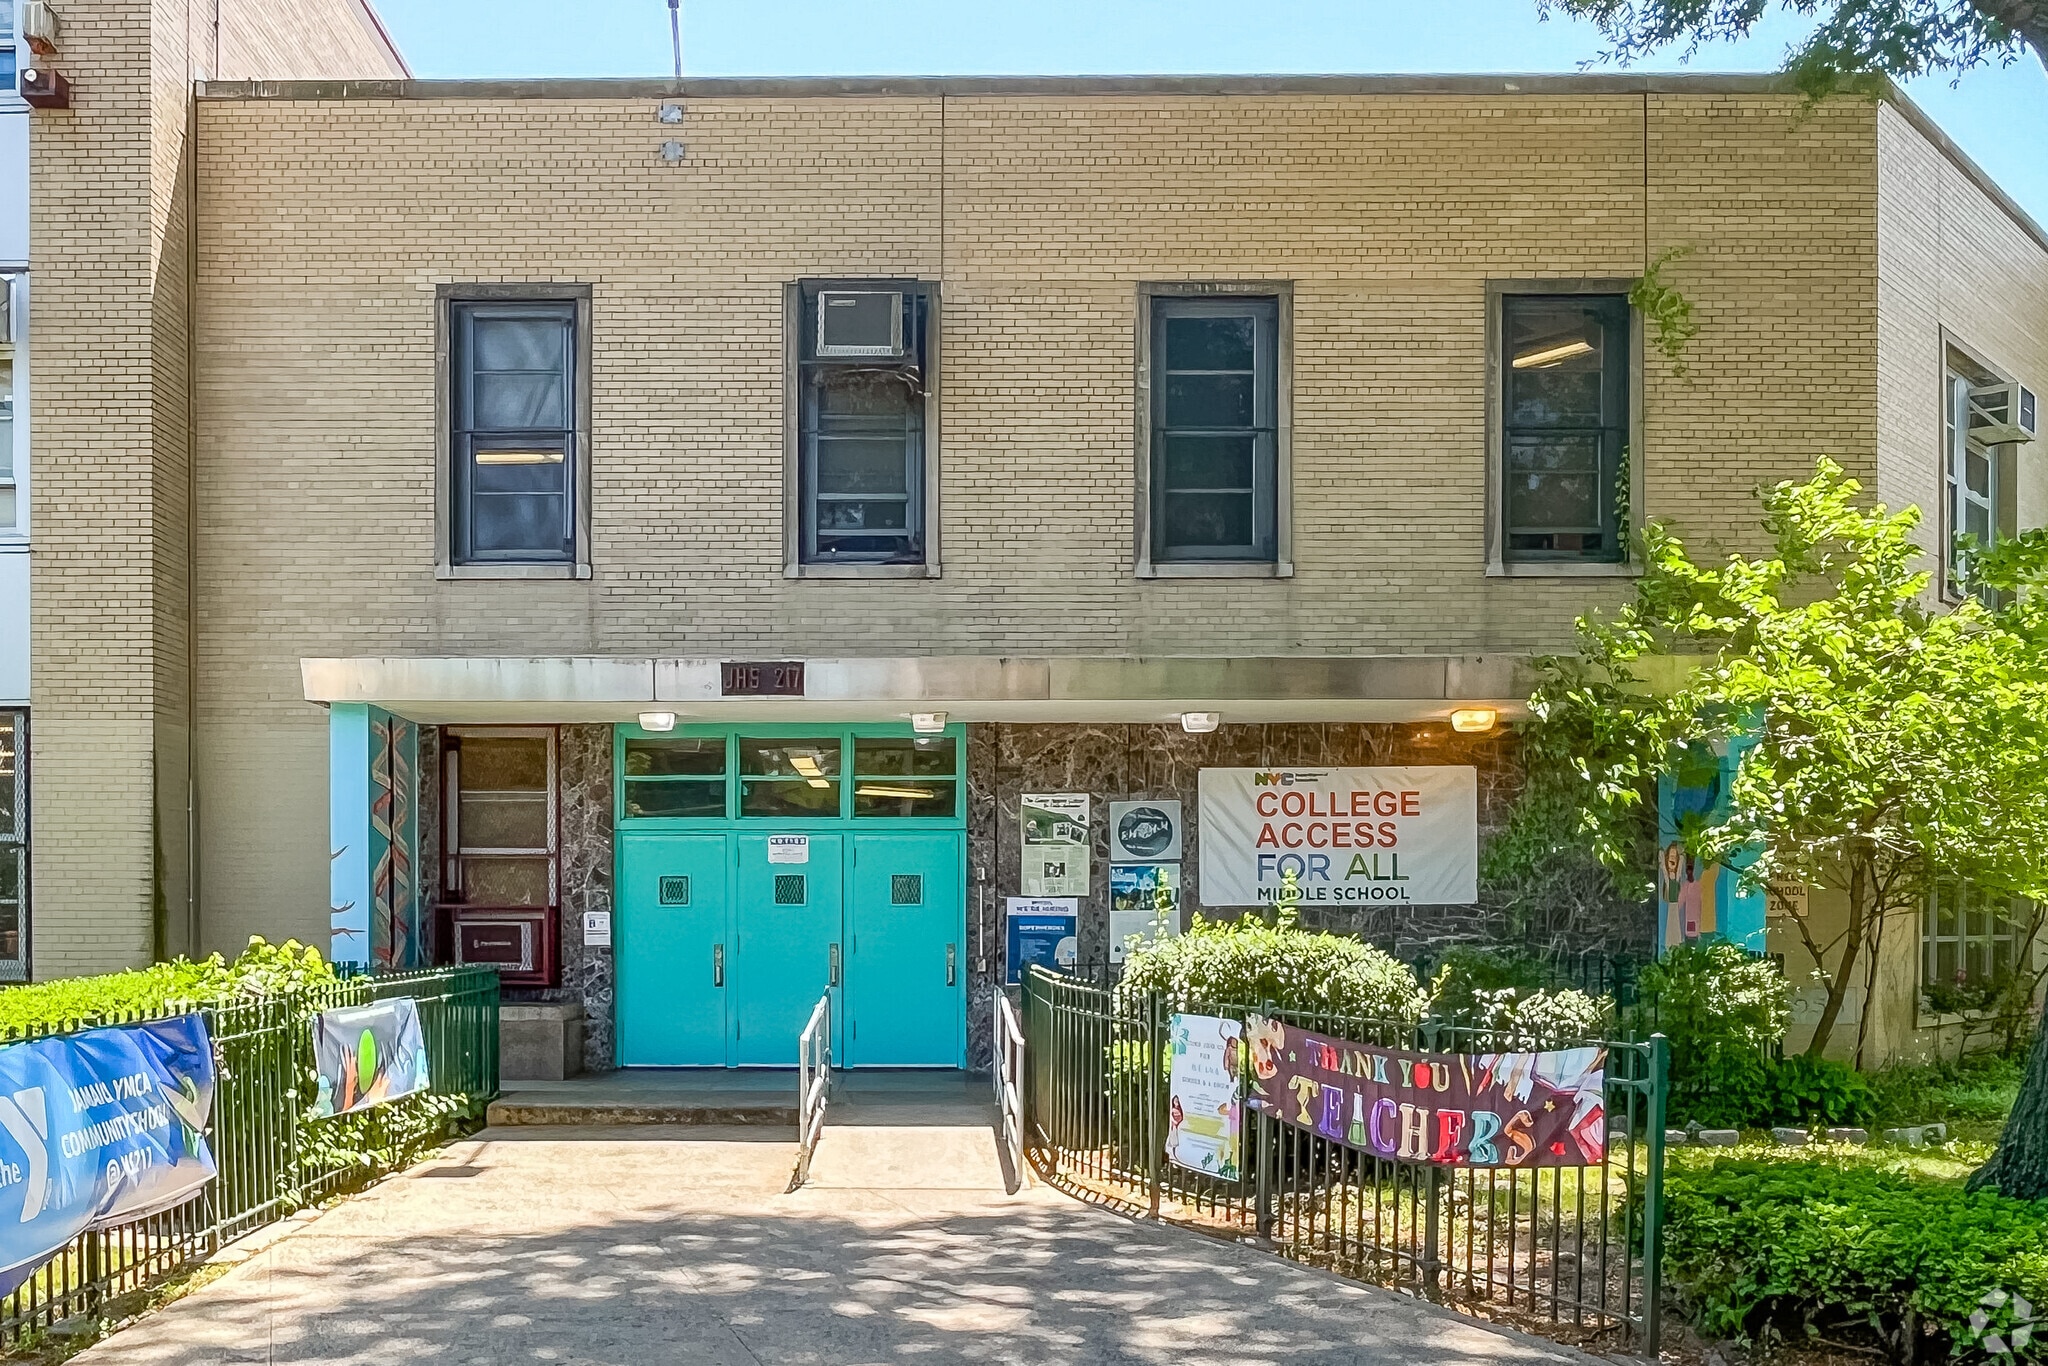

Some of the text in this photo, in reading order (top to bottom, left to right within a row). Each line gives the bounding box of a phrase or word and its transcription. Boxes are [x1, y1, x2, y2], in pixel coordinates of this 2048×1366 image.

[725, 667, 800, 689] JHS 217
[1255, 772, 1294, 786] NYC
[1256, 791, 1420, 817] COLLEGE
[1256, 822, 1398, 848] ACCESS
[1258, 853, 1410, 881] FOR ALL
[1257, 886, 1410, 901] MIDDLE SCHOOL
[1768, 886, 1806, 896] HOOL
[1305, 1038, 1450, 1092] THANK YOU
[113, 1071, 152, 1101] YMCA
[1288, 1074, 1537, 1165] TEACHERS
[61, 1114, 132, 1159] COMMUNITY
[0, 1158, 23, 1188] he
